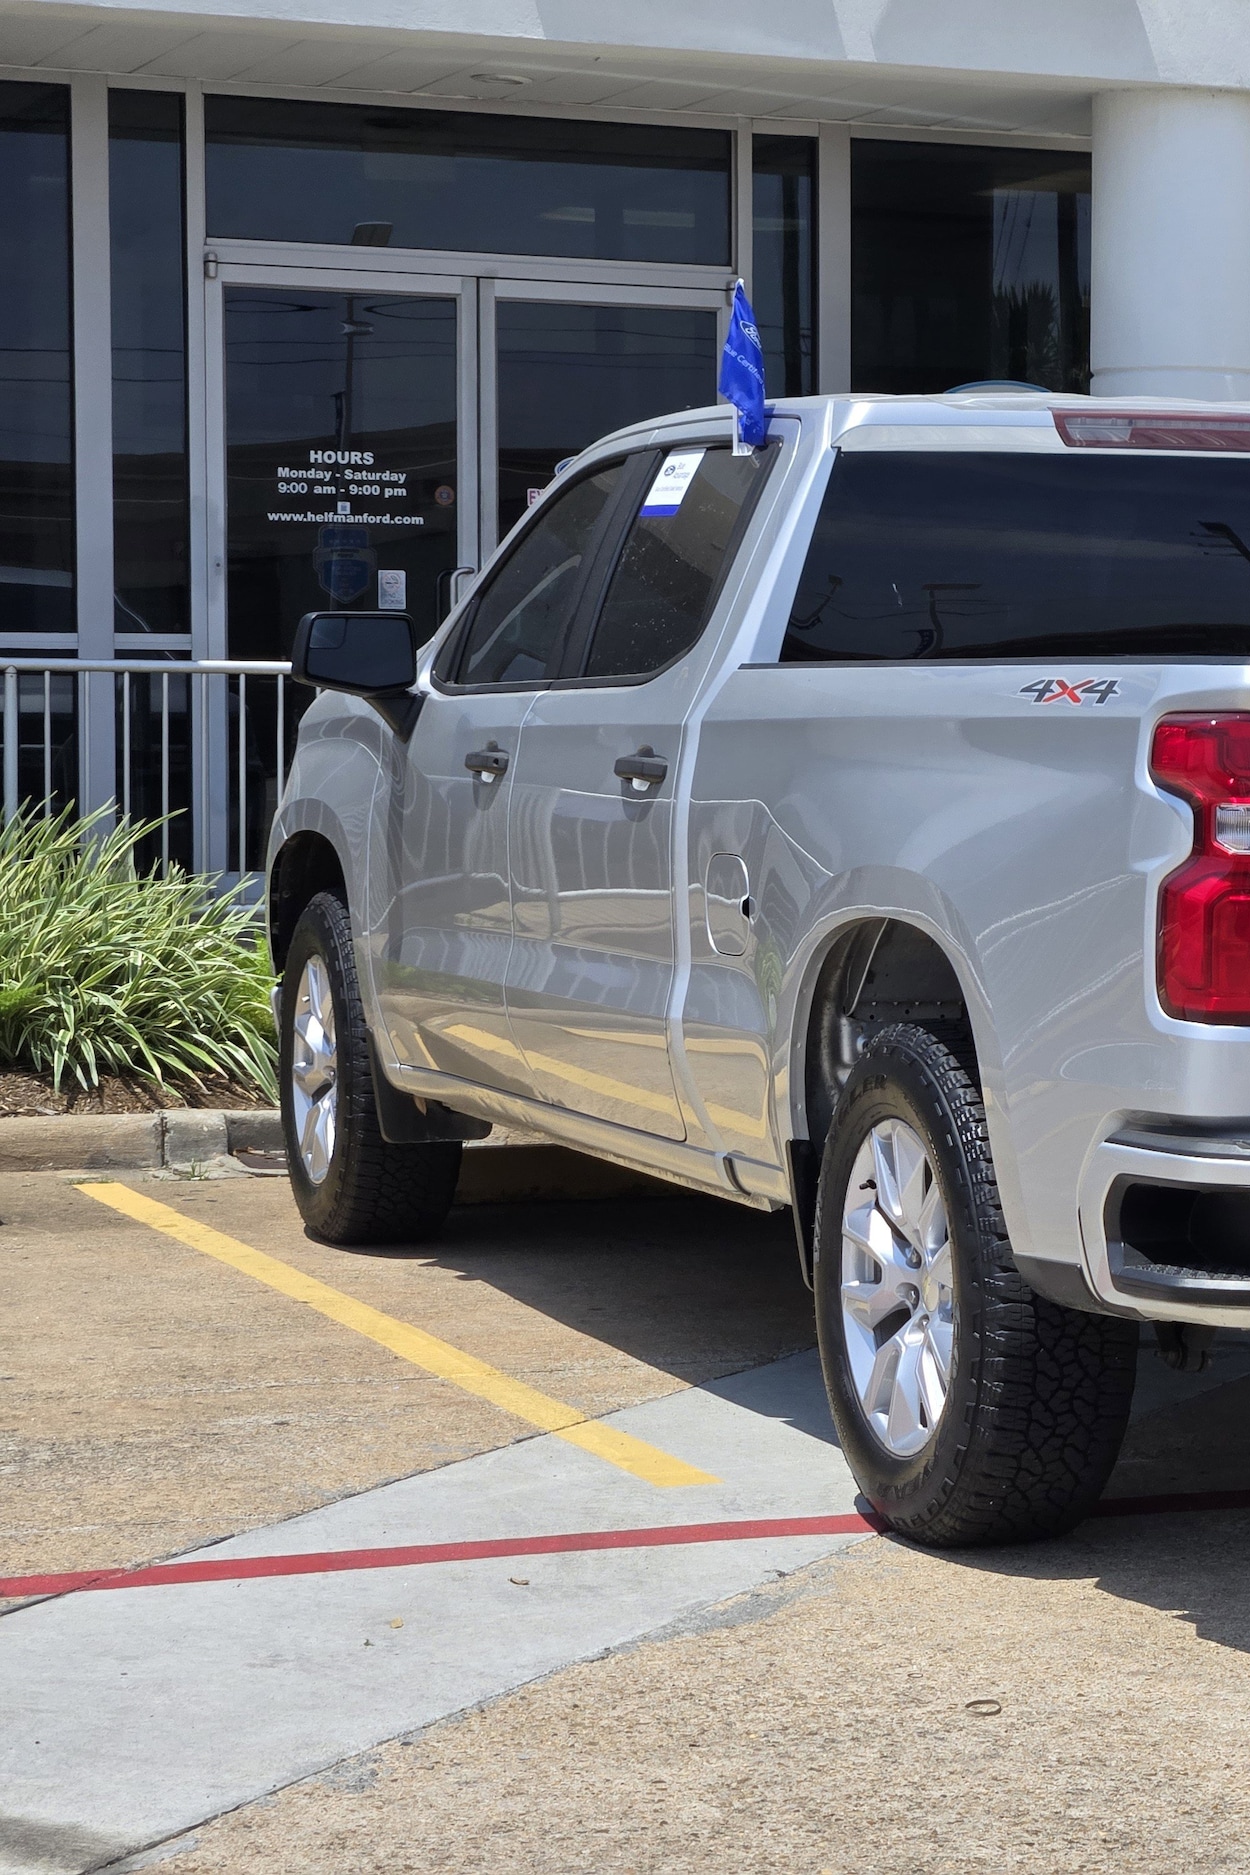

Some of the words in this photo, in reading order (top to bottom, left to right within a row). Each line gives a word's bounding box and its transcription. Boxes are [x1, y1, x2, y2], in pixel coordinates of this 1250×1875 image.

[309, 450, 375, 465] HOURS
[277, 467, 332, 481] Monday
[344, 469, 407, 484] Saturday
[278, 482, 308, 494] 9:00
[313, 484, 336, 495] am
[349, 484, 380, 496] 9:00
[384, 487, 407, 498] pm
[267, 511, 424, 525] www.helfmanford.com
